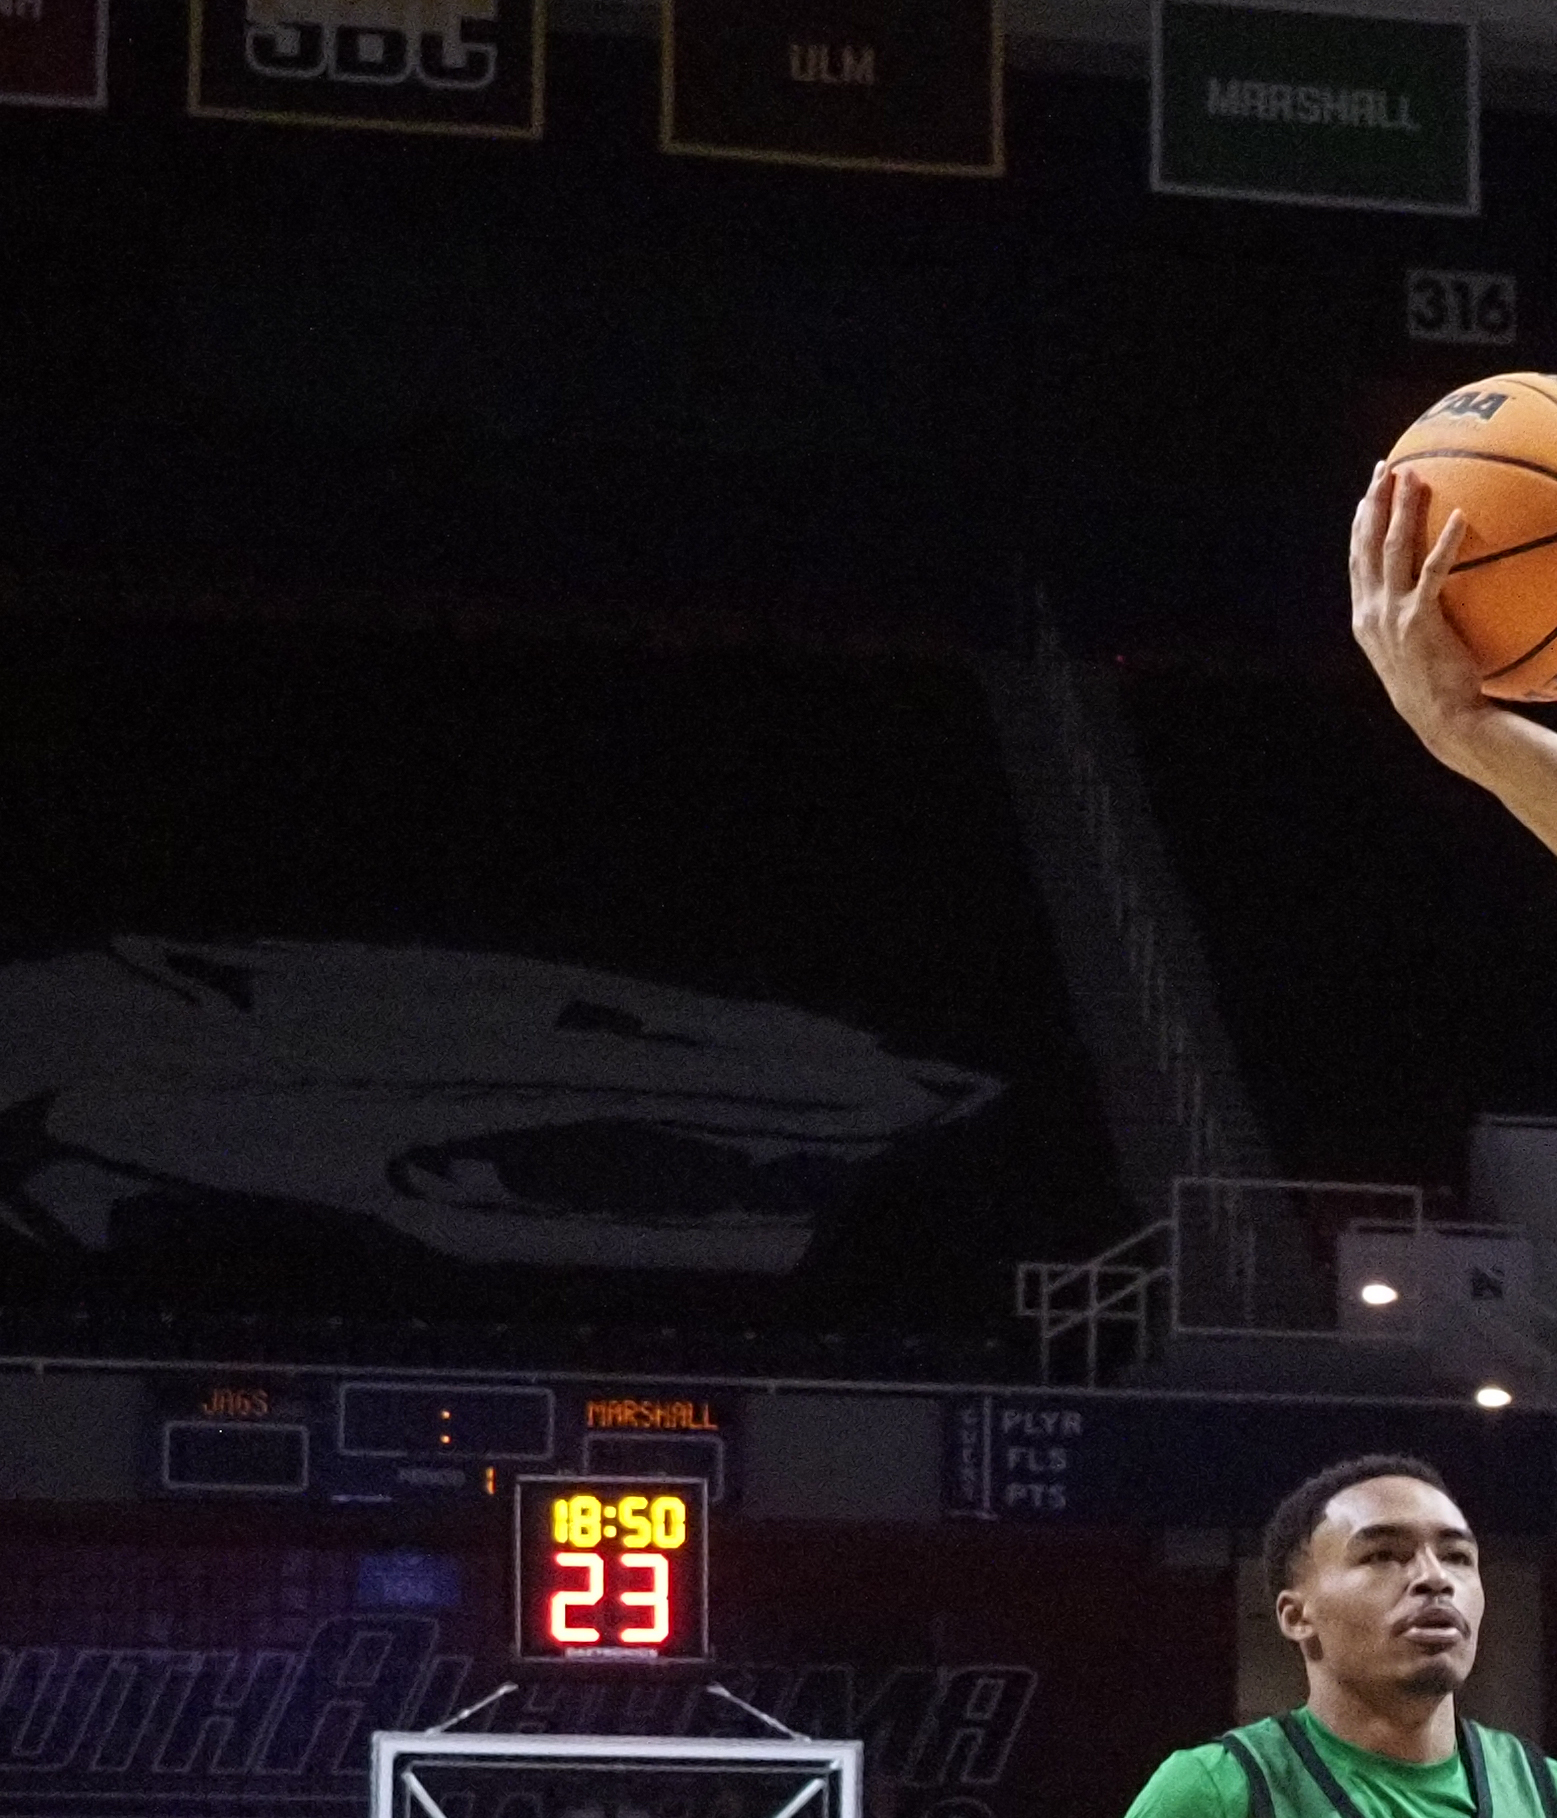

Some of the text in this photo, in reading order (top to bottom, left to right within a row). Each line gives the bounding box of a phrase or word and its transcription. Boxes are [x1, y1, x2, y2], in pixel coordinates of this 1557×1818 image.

[789, 44, 876, 86] ULM
[1207, 76, 1421, 131] MARSHALL
[1410, 279, 1513, 335] 316
[202, 1388, 270, 1417] JAGS
[586, 1399, 720, 1430] MARSHALL
[1001, 1409, 1083, 1436] PLYR
[1005, 1445, 1069, 1474] FLS
[1003, 1481, 1068, 1510] PTS
[554, 1495, 687, 1549] 18:50
[551, 1552, 669, 1643] 23
